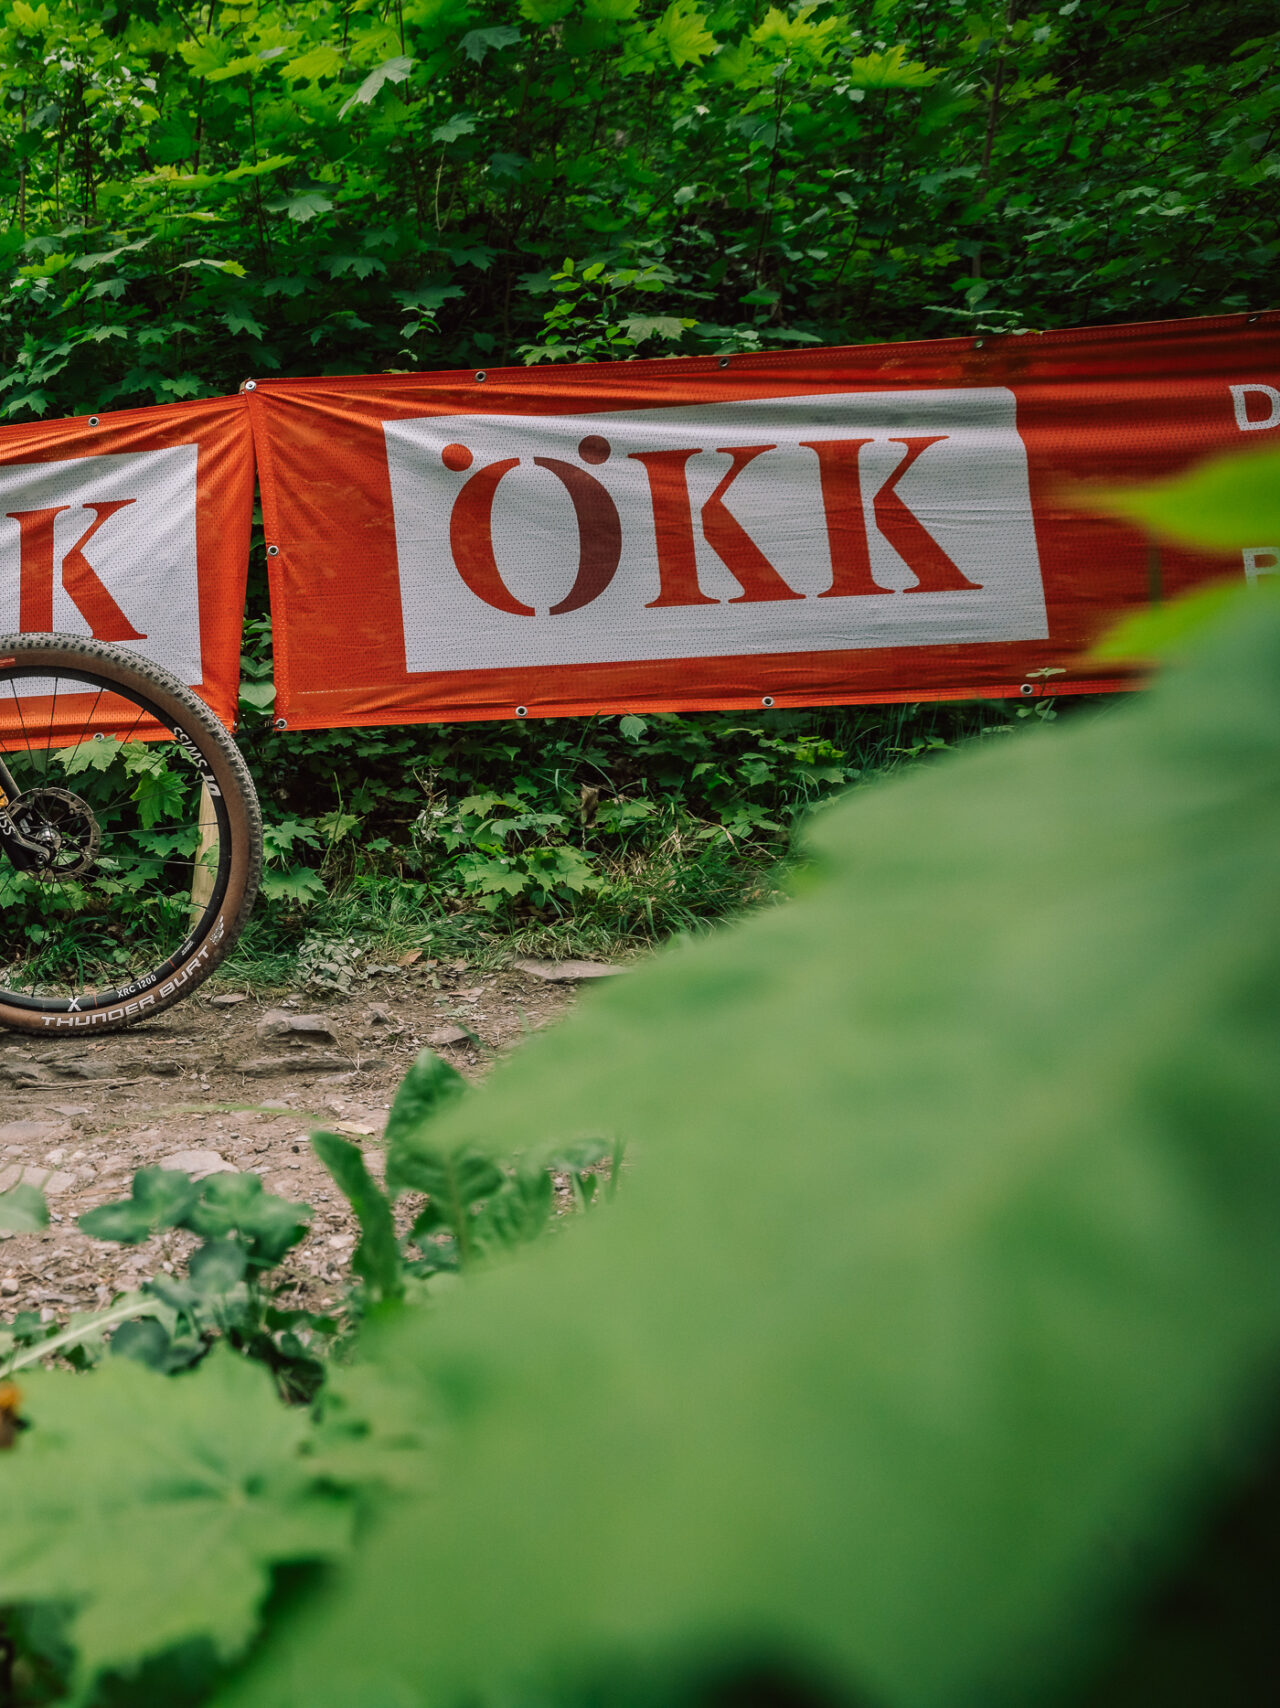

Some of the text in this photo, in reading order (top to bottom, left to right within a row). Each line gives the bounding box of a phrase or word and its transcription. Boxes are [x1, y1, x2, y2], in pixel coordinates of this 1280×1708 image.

[440, 434, 984, 617] ÖKK
[173, 727, 221, 797] DT SWISS
[41, 945, 209, 1027] THUNDER BURT
[116, 974, 157, 998] XRC 1200
